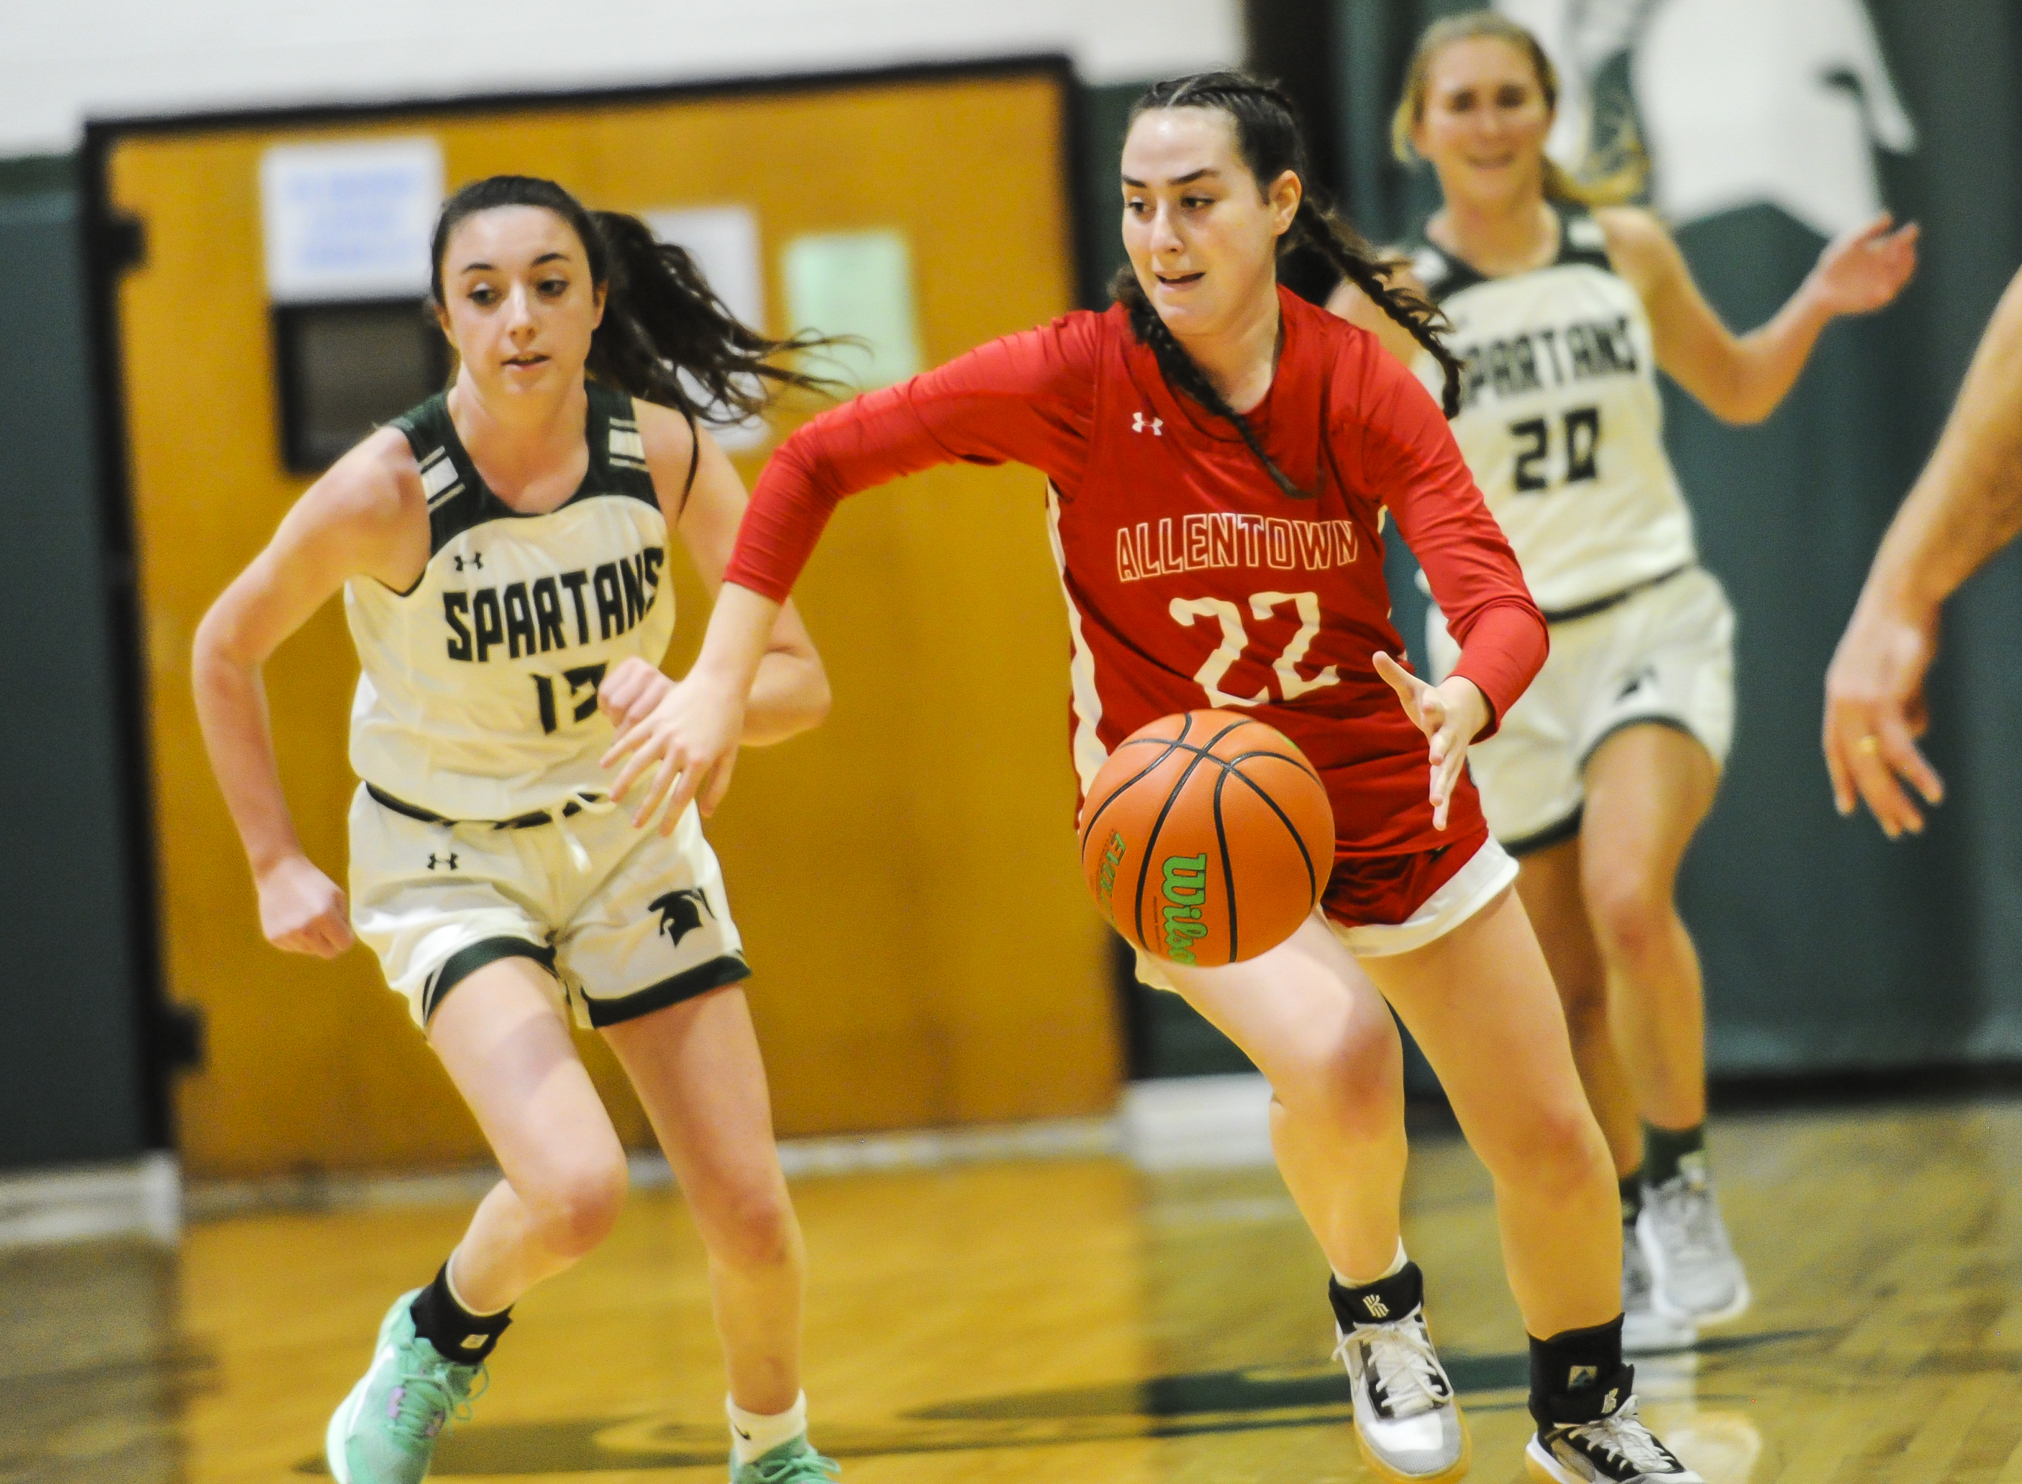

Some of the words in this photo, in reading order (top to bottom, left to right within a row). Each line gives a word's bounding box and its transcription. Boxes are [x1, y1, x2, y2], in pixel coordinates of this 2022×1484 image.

[1458, 315, 1638, 408] PARTANS
[1508, 407, 1600, 492] 20
[1116, 512, 1359, 583] ALLENTOWN
[442, 546, 665, 663] SPARTANS
[1169, 591, 1341, 709] 22
[1162, 853, 1208, 966] Wilso
